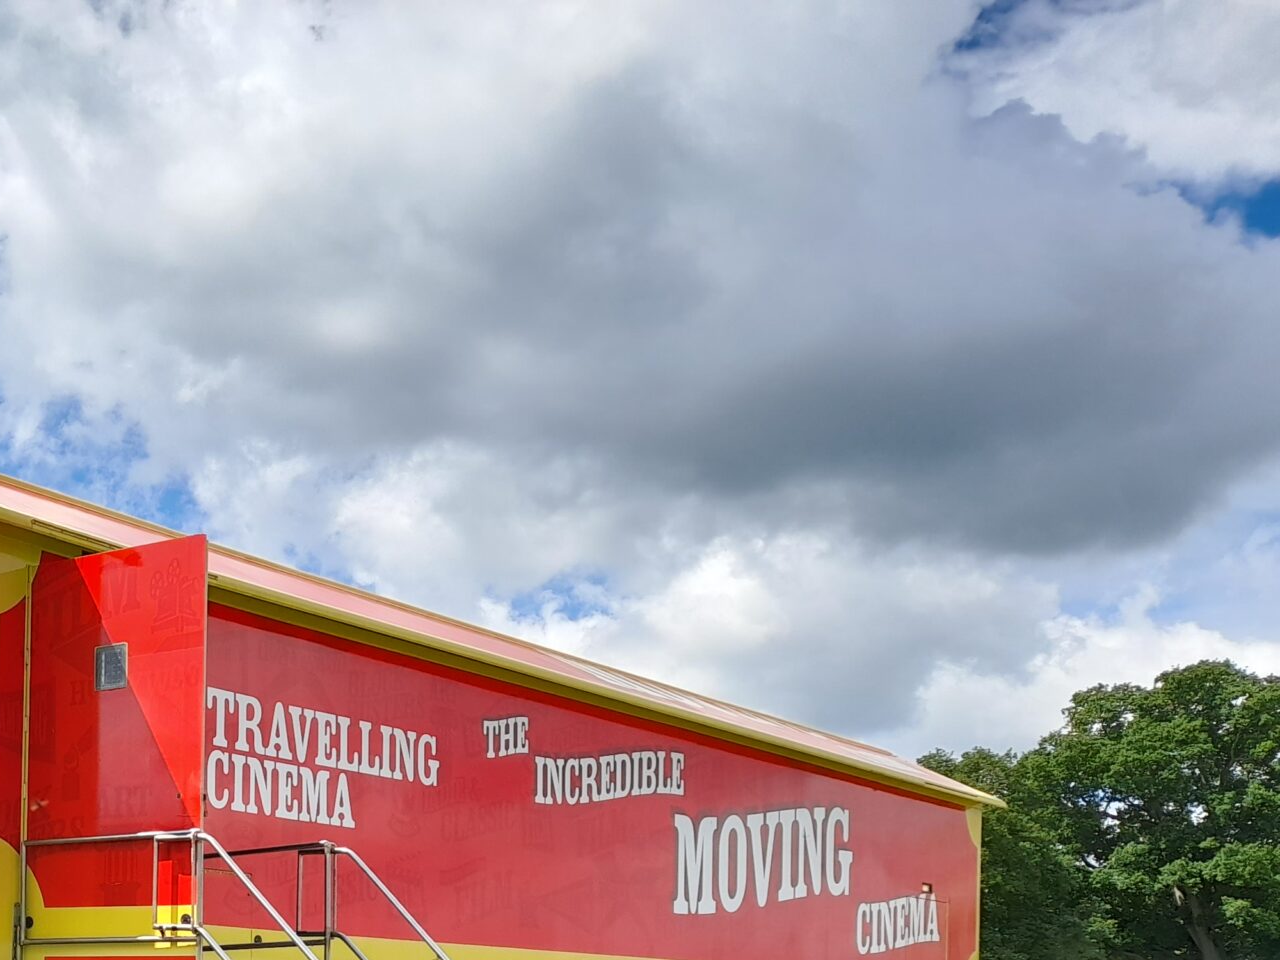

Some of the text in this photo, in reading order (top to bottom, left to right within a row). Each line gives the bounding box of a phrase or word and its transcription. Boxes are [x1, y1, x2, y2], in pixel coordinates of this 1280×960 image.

[207, 686, 440, 788] TRAVELLING
[483, 716, 529, 759] THE
[207, 749, 356, 830] CINEMA
[535, 751, 685, 805] INCREDIBLE
[673, 806, 853, 916] MOVING
[856, 891, 940, 955] CINEMA
